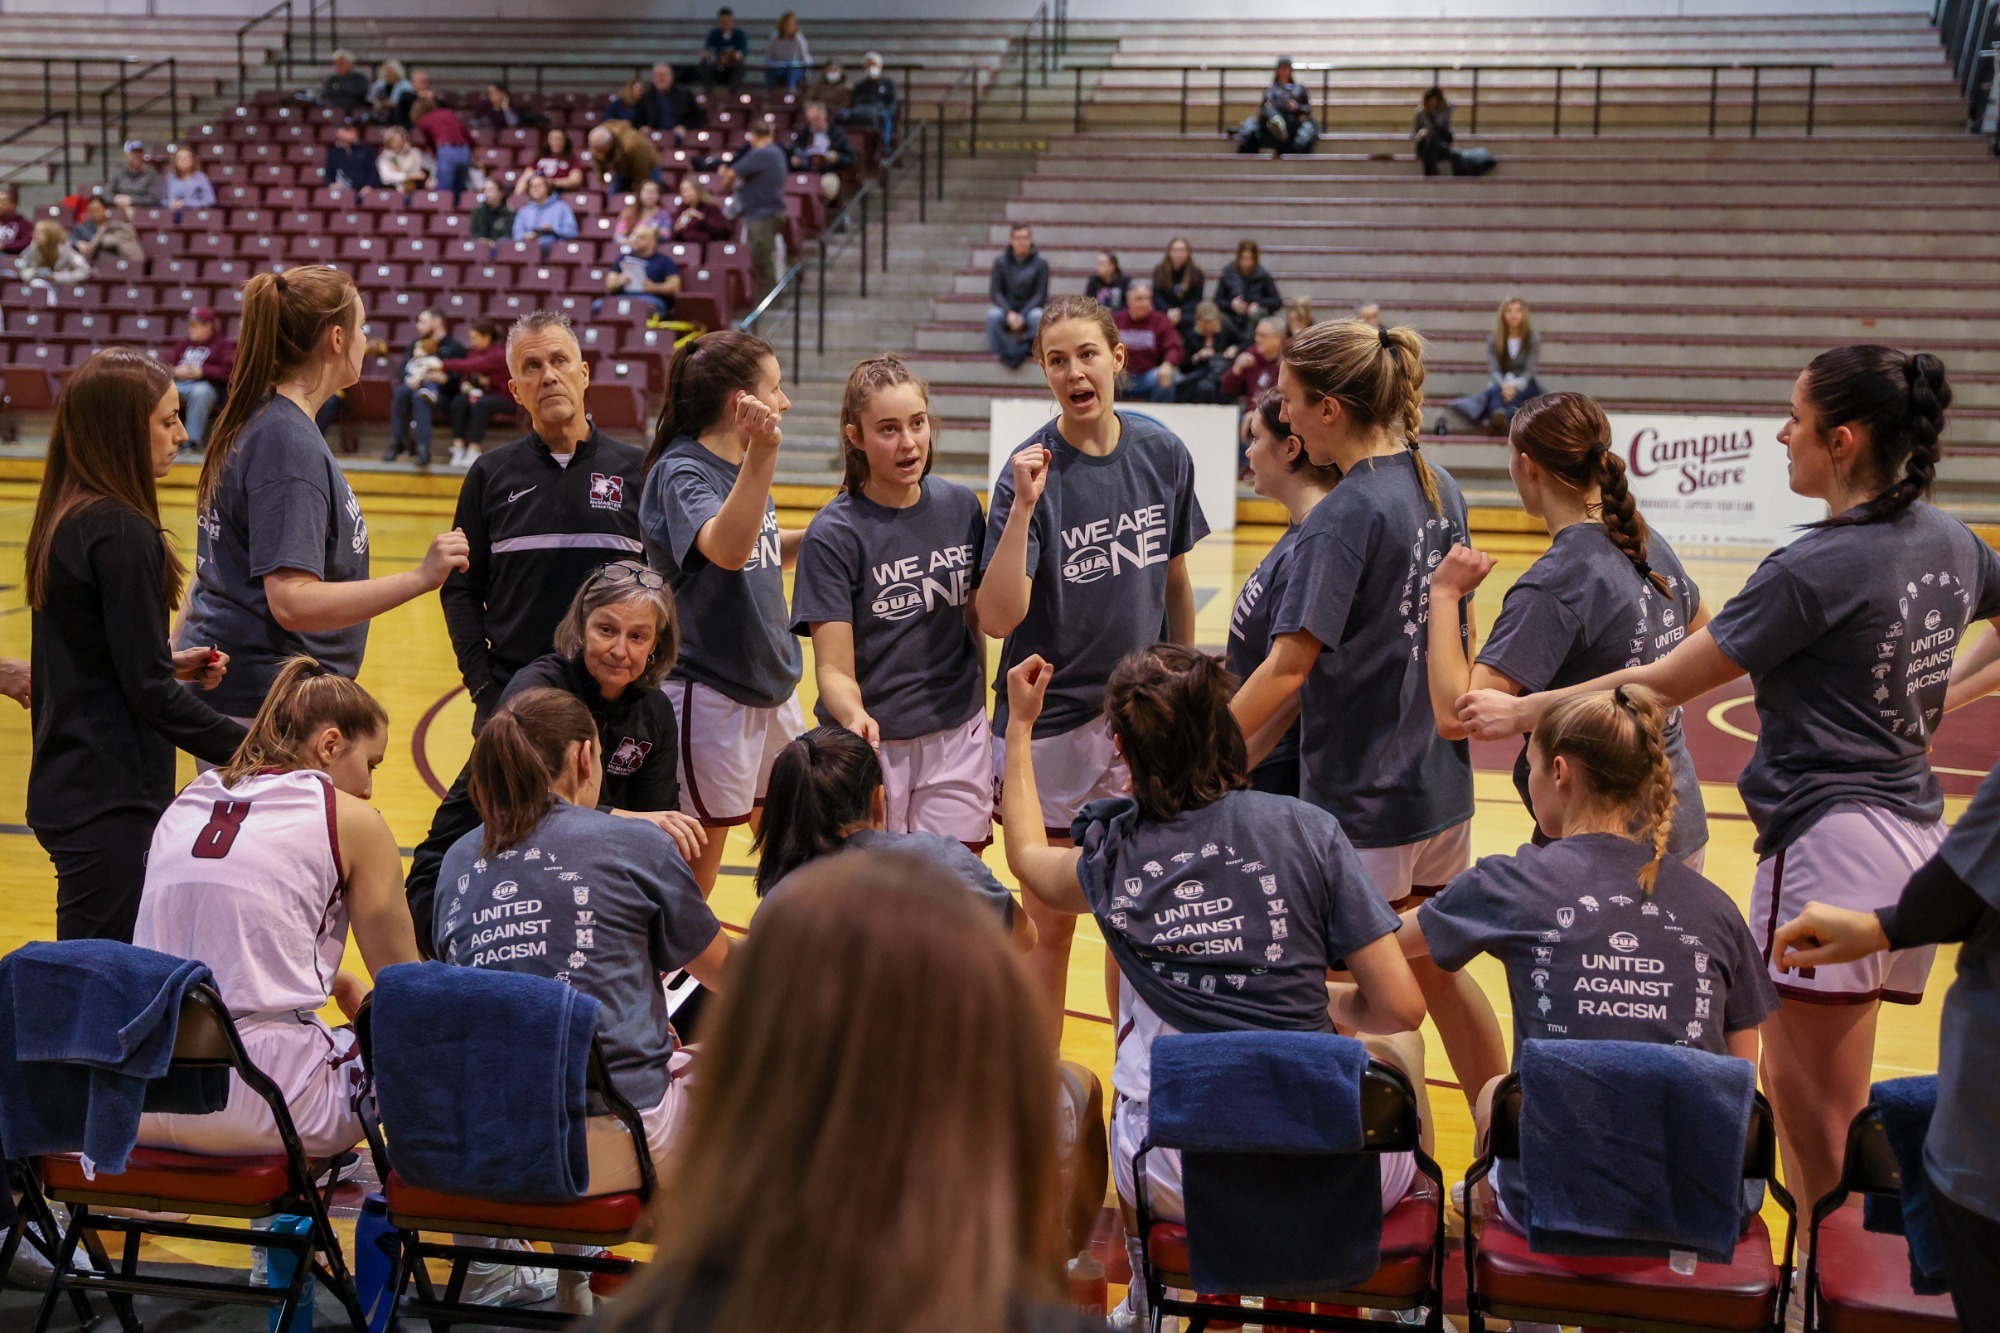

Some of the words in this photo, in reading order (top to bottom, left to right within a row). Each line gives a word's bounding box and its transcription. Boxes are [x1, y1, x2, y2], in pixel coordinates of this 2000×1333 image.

[1628, 427, 1754, 477] Campus
[1677, 463, 1745, 495] Store
[1061, 518, 1111, 549] WE
[1115, 504, 1165, 536] ARE
[872, 556, 923, 586] WE
[928, 544, 973, 574] ARE
[1062, 553, 1111, 580] OUA
[1110, 527, 1168, 576] NE
[872, 588, 923, 613] OUA
[1924, 612, 1941, 628] OUA
[1655, 625, 1685, 649] UNITED
[1911, 628, 1954, 654] UNITED
[1906, 645, 1956, 677] AGAINST
[1906, 667, 1951, 696] RACISM
[191, 800, 252, 859] 8
[492, 883, 518, 897] OUA
[1174, 883, 1204, 897] OUA
[472, 900, 542, 925] UNITED
[1154, 898, 1233, 925] UNITED
[471, 919, 551, 948] AGAINST
[1151, 915, 1244, 943] AGAINST
[1608, 936, 1639, 948] OUA
[473, 941, 546, 967] RACISM
[1156, 937, 1243, 955] RACISM
[1582, 954, 1665, 973] UNITED
[1573, 977, 1673, 997] AGAINST
[1577, 1000, 1667, 1020] RACISM
